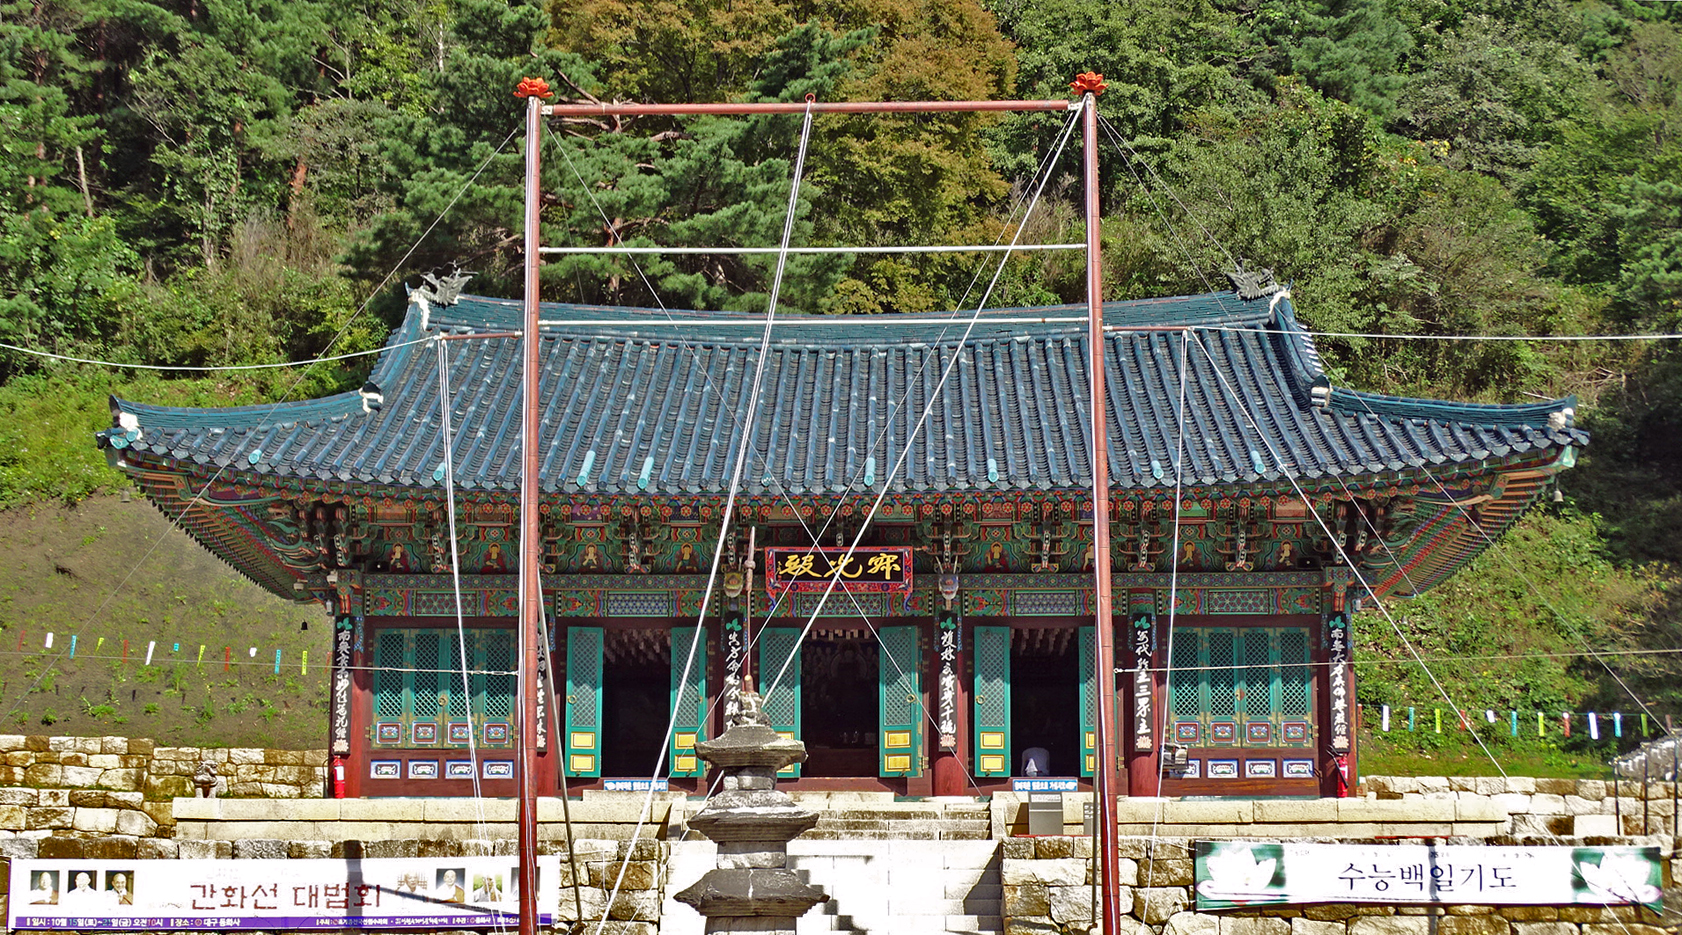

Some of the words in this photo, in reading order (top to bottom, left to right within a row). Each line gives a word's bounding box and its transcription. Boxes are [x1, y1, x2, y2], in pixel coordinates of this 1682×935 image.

[1338, 863, 1517, 892] 수능백일기도
[190, 883, 278, 910] 간화선
[292, 882, 380, 909] 대법회
